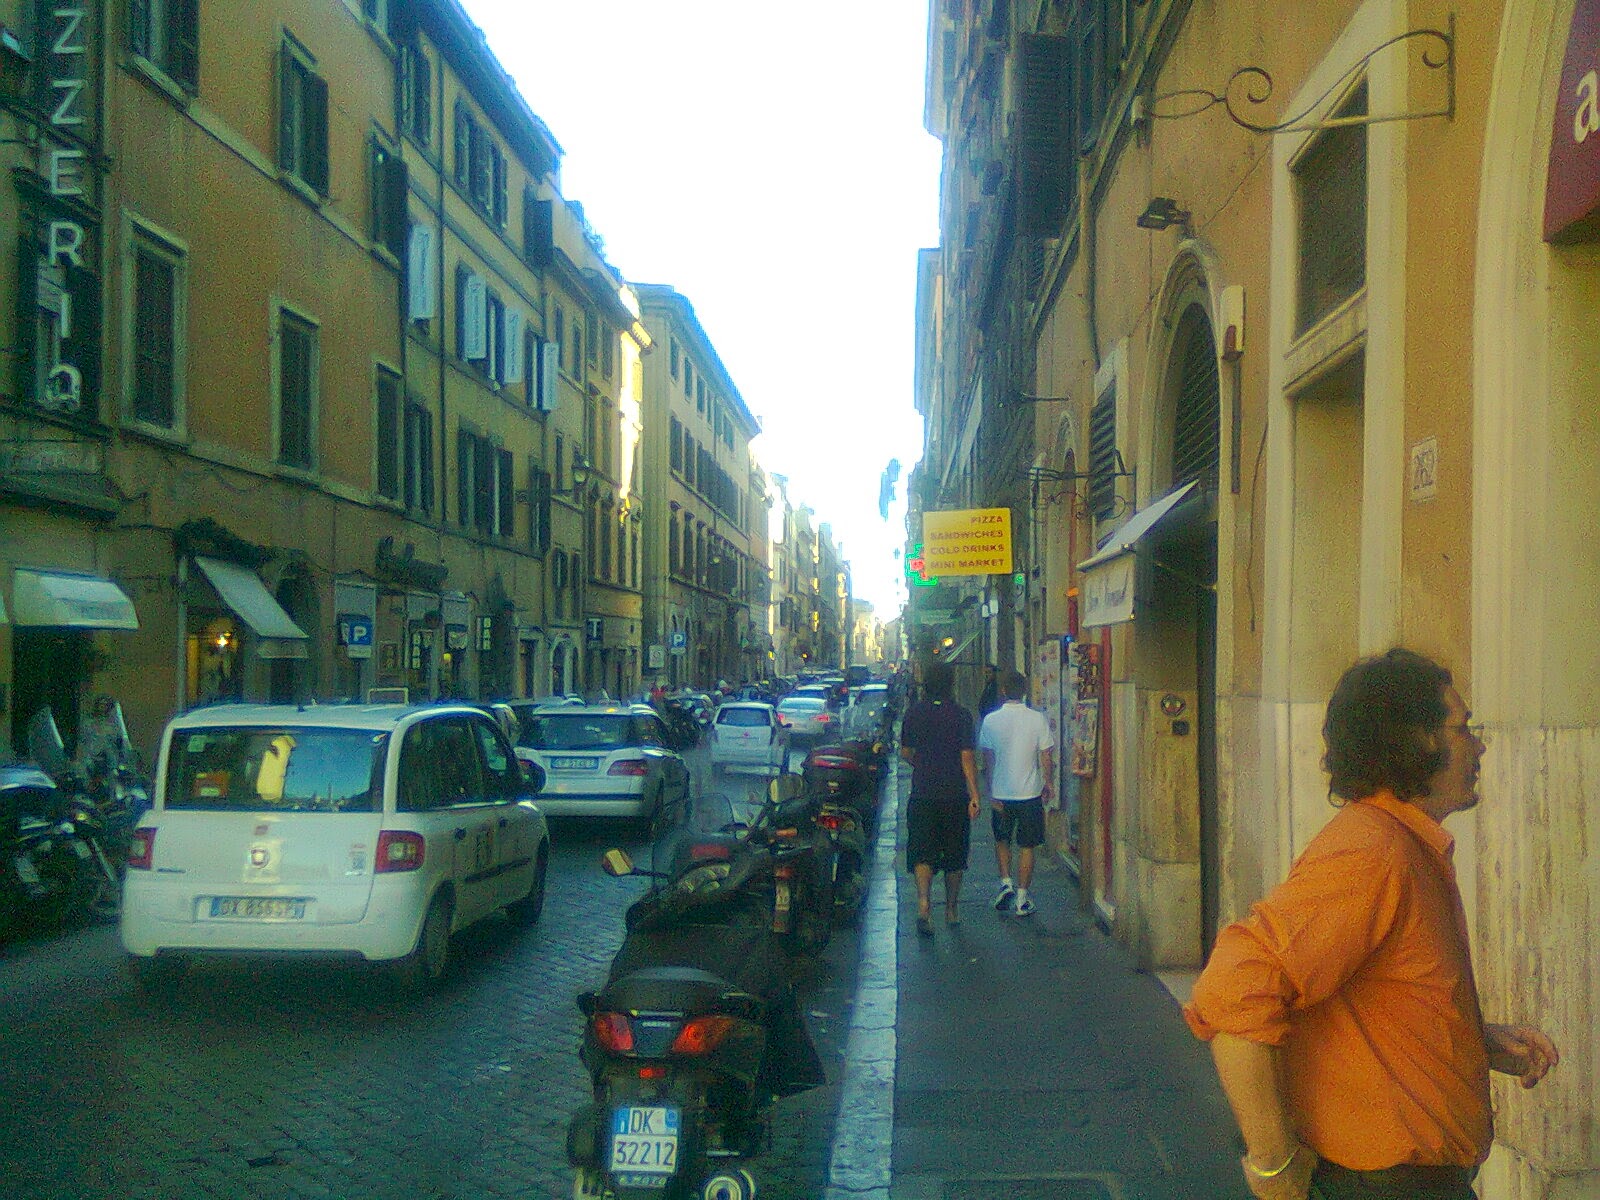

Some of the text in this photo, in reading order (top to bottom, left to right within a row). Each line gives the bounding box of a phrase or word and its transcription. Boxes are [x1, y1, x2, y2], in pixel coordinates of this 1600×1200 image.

[970, 515, 1003, 524] PIZZA
[930, 529, 1004, 540] SANDWICHES
[930, 543, 1005, 555] COLD DRINKS
[930, 558, 1005, 569] MINI MARKET
[353, 625, 367, 642] P
[673, 634, 683, 647] P
[630, 1109, 655, 1133] DK
[615, 1141, 675, 1166] 32212
